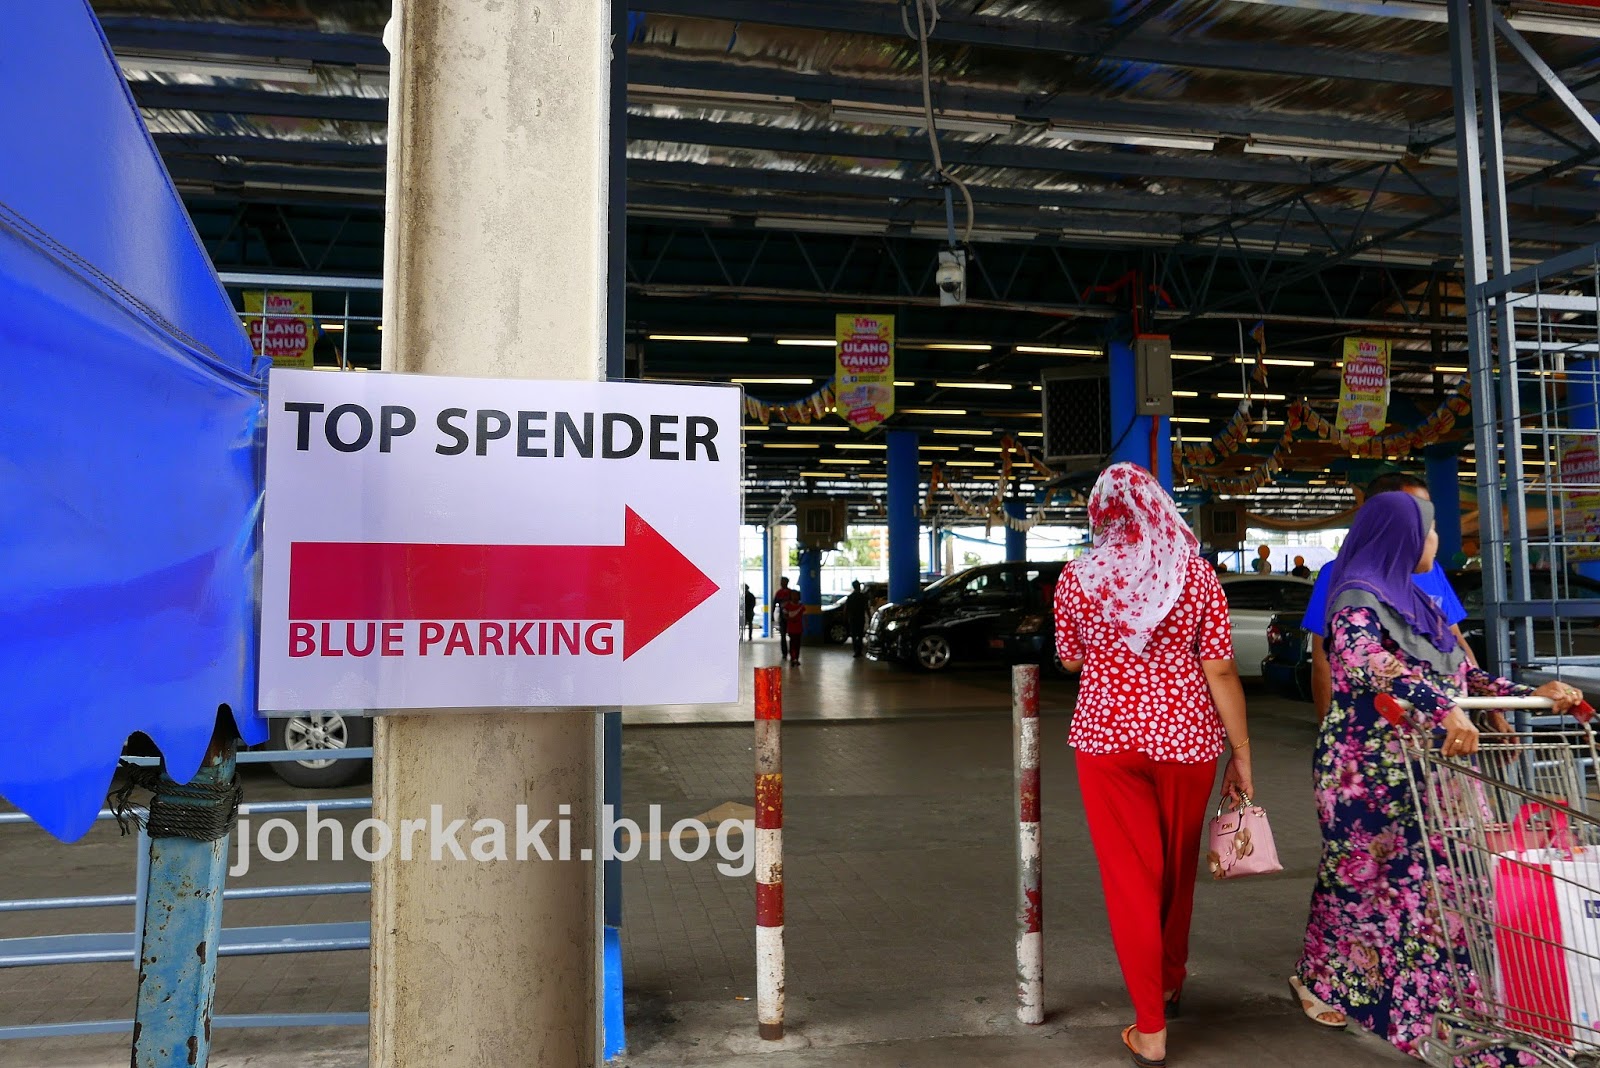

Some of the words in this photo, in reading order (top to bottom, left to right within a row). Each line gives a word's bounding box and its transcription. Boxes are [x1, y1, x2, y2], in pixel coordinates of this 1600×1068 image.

[253, 323, 304, 335] ULANG
[252, 337, 306, 349] TAHUN
[843, 342, 888, 353] ULANG
[841, 355, 889, 366] TAHUN
[1347, 363, 1384, 376] ULANG
[1345, 375, 1383, 387] TAHUN
[284, 401, 417, 454] TOP
[434, 407, 721, 462] SPENDER
[288, 622, 405, 658] BLUE
[418, 622, 615, 657] PARKING
